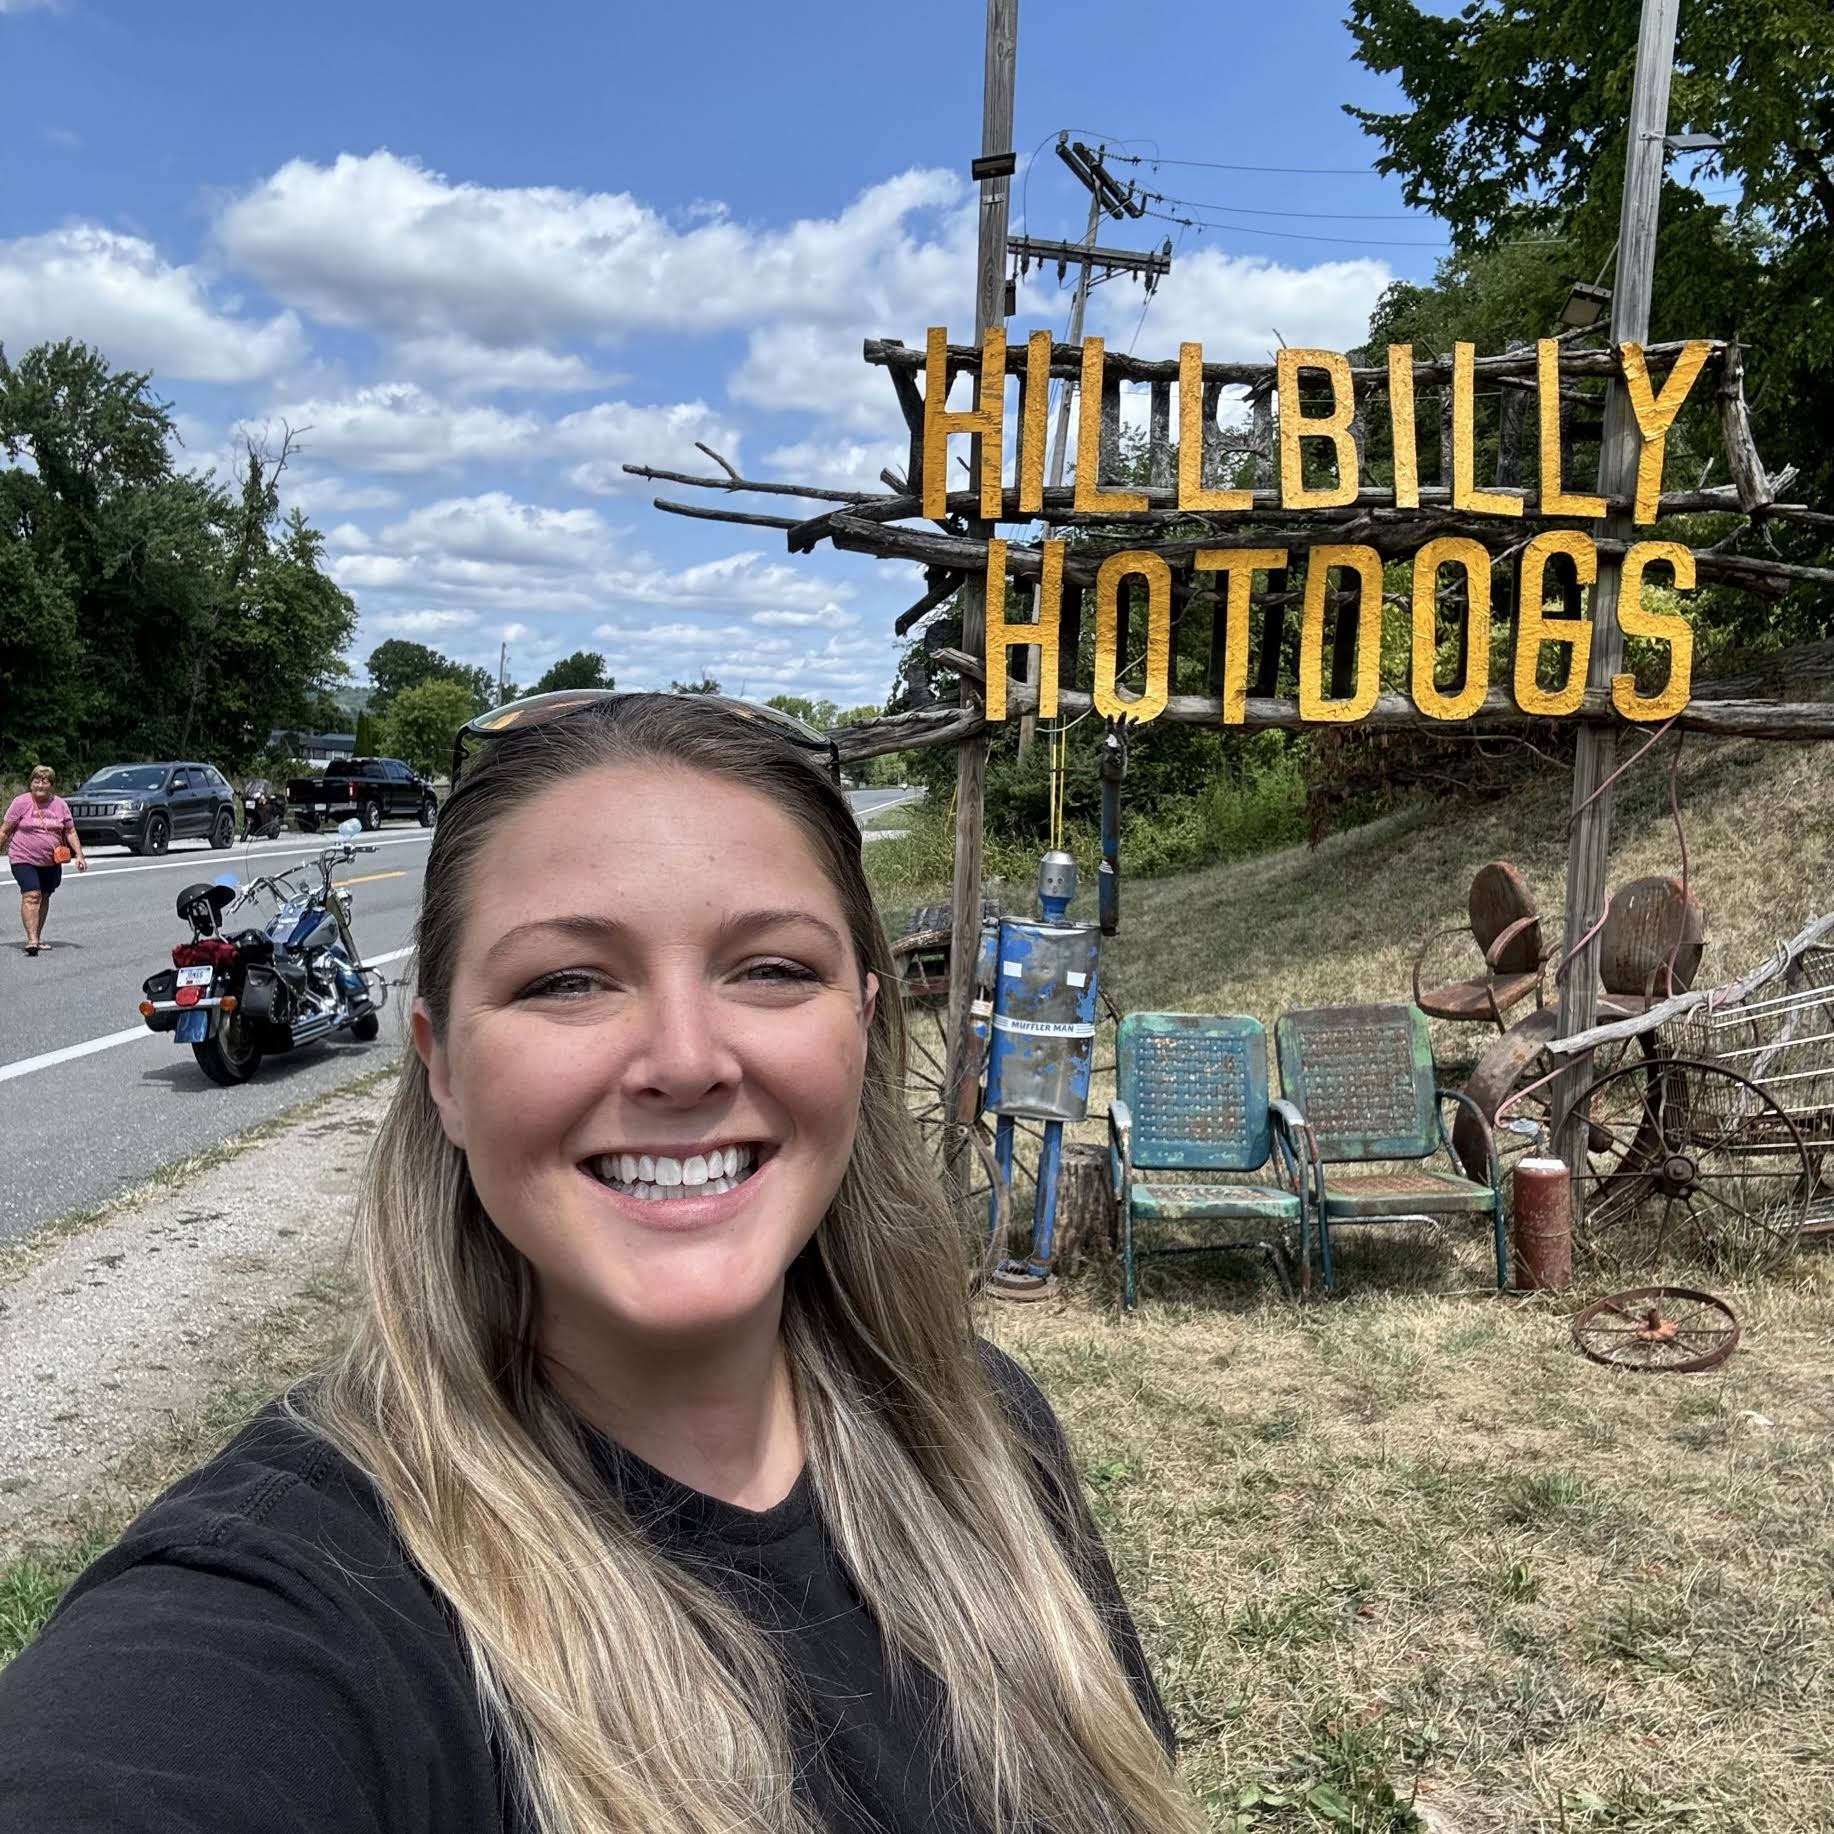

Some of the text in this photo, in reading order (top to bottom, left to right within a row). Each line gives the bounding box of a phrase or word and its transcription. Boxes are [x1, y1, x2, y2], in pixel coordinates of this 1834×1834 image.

[923, 327, 1711, 526] HILLBILLY
[1011, 1021, 1074, 1033] MUFFLER MAN
